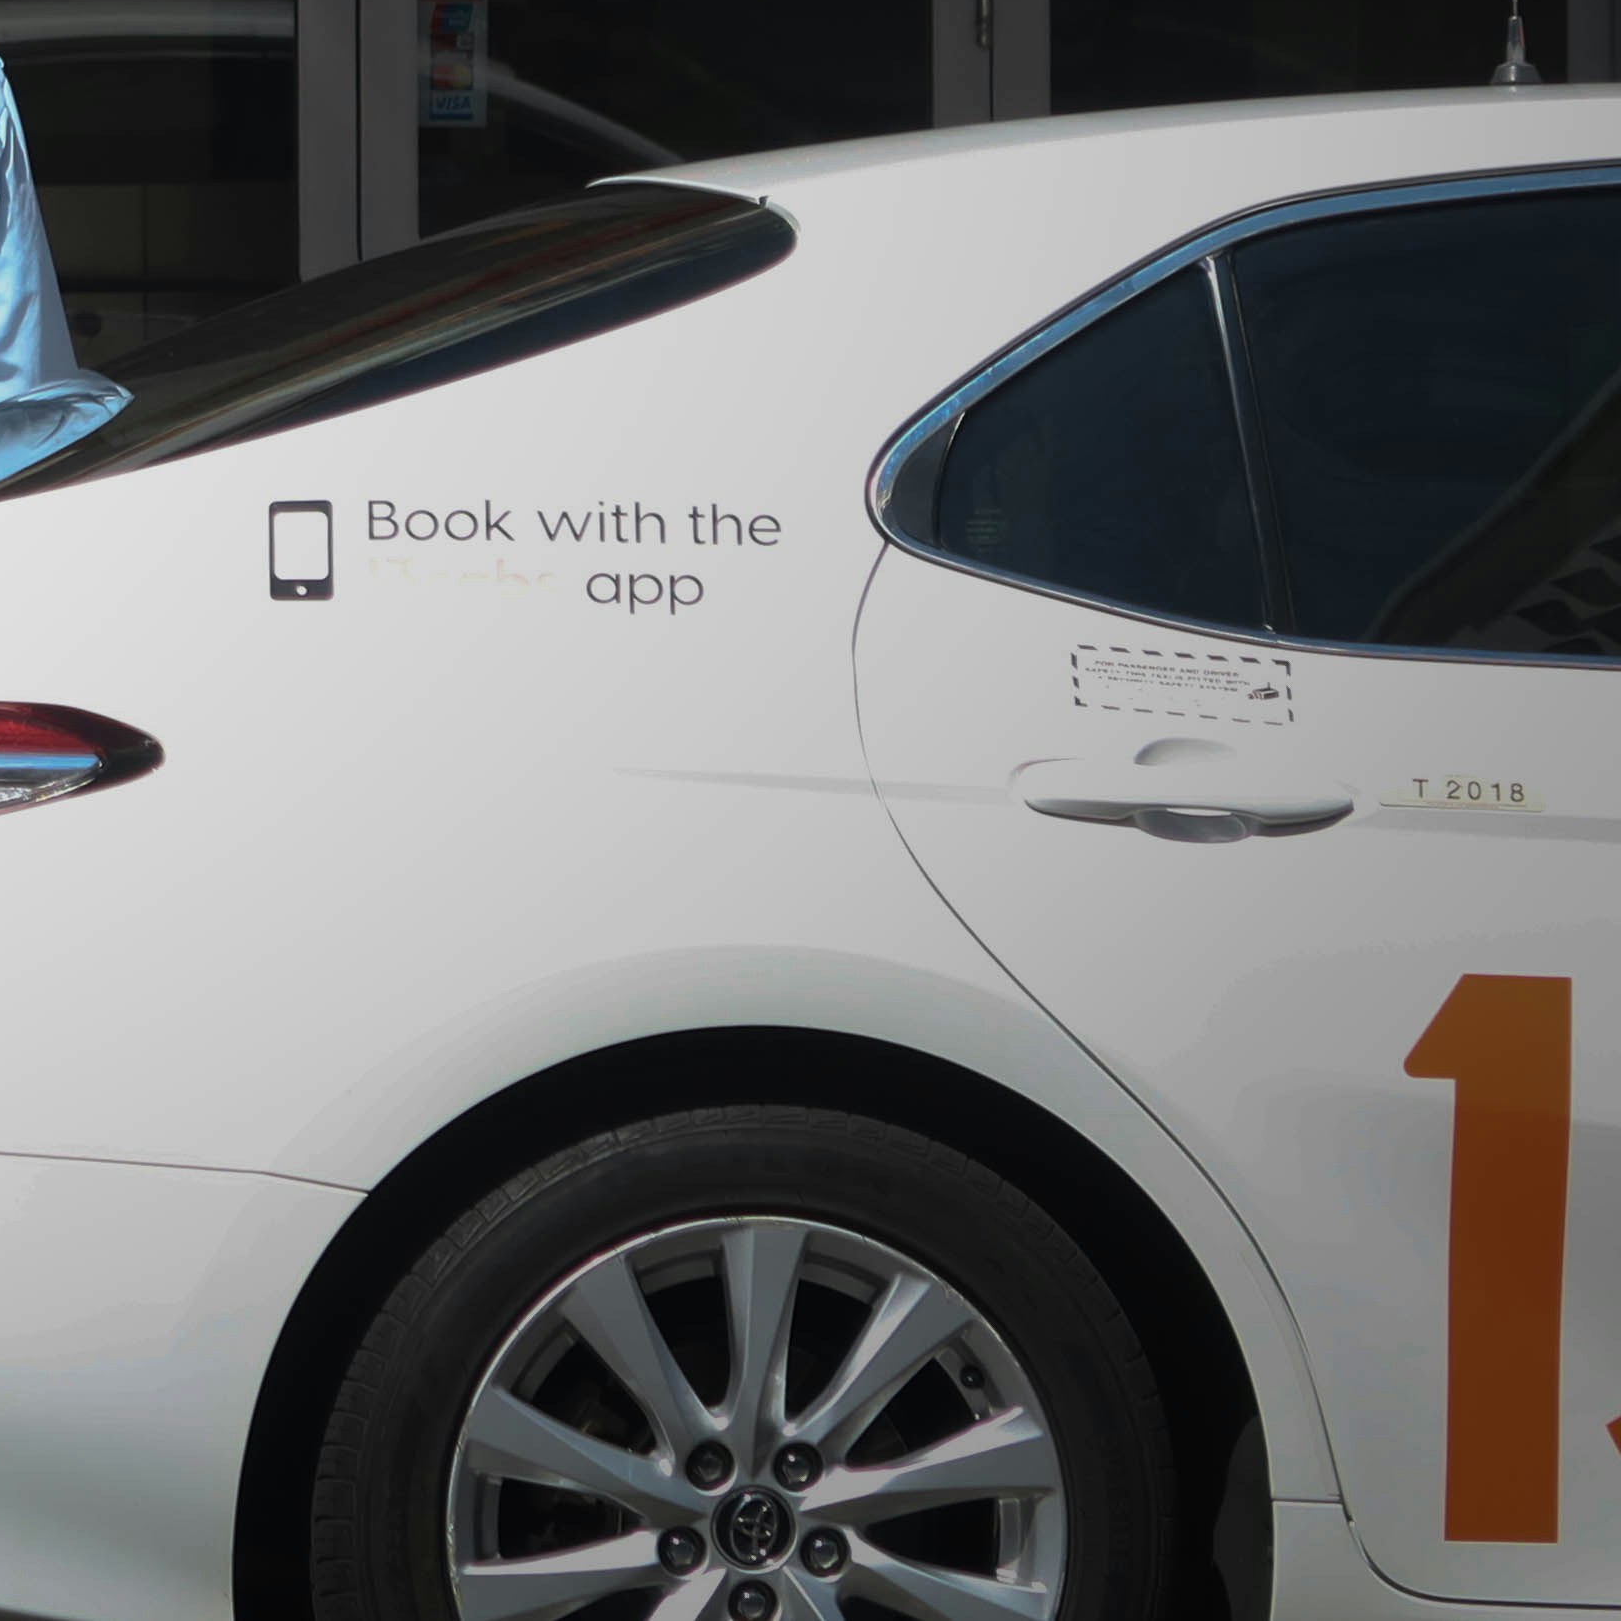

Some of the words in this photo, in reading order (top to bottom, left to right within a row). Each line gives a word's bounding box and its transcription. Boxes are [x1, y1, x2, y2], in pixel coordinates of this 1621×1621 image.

[435, 96, 472, 111] VISA
[366, 498, 518, 543] Book
[536, 499, 667, 545] with
[687, 501, 783, 547] the
[585, 570, 706, 617] app
[1413, 778, 1429, 798] T
[1446, 780, 1525, 803] 2018
[1403, 973, 1621, 1544] 1
